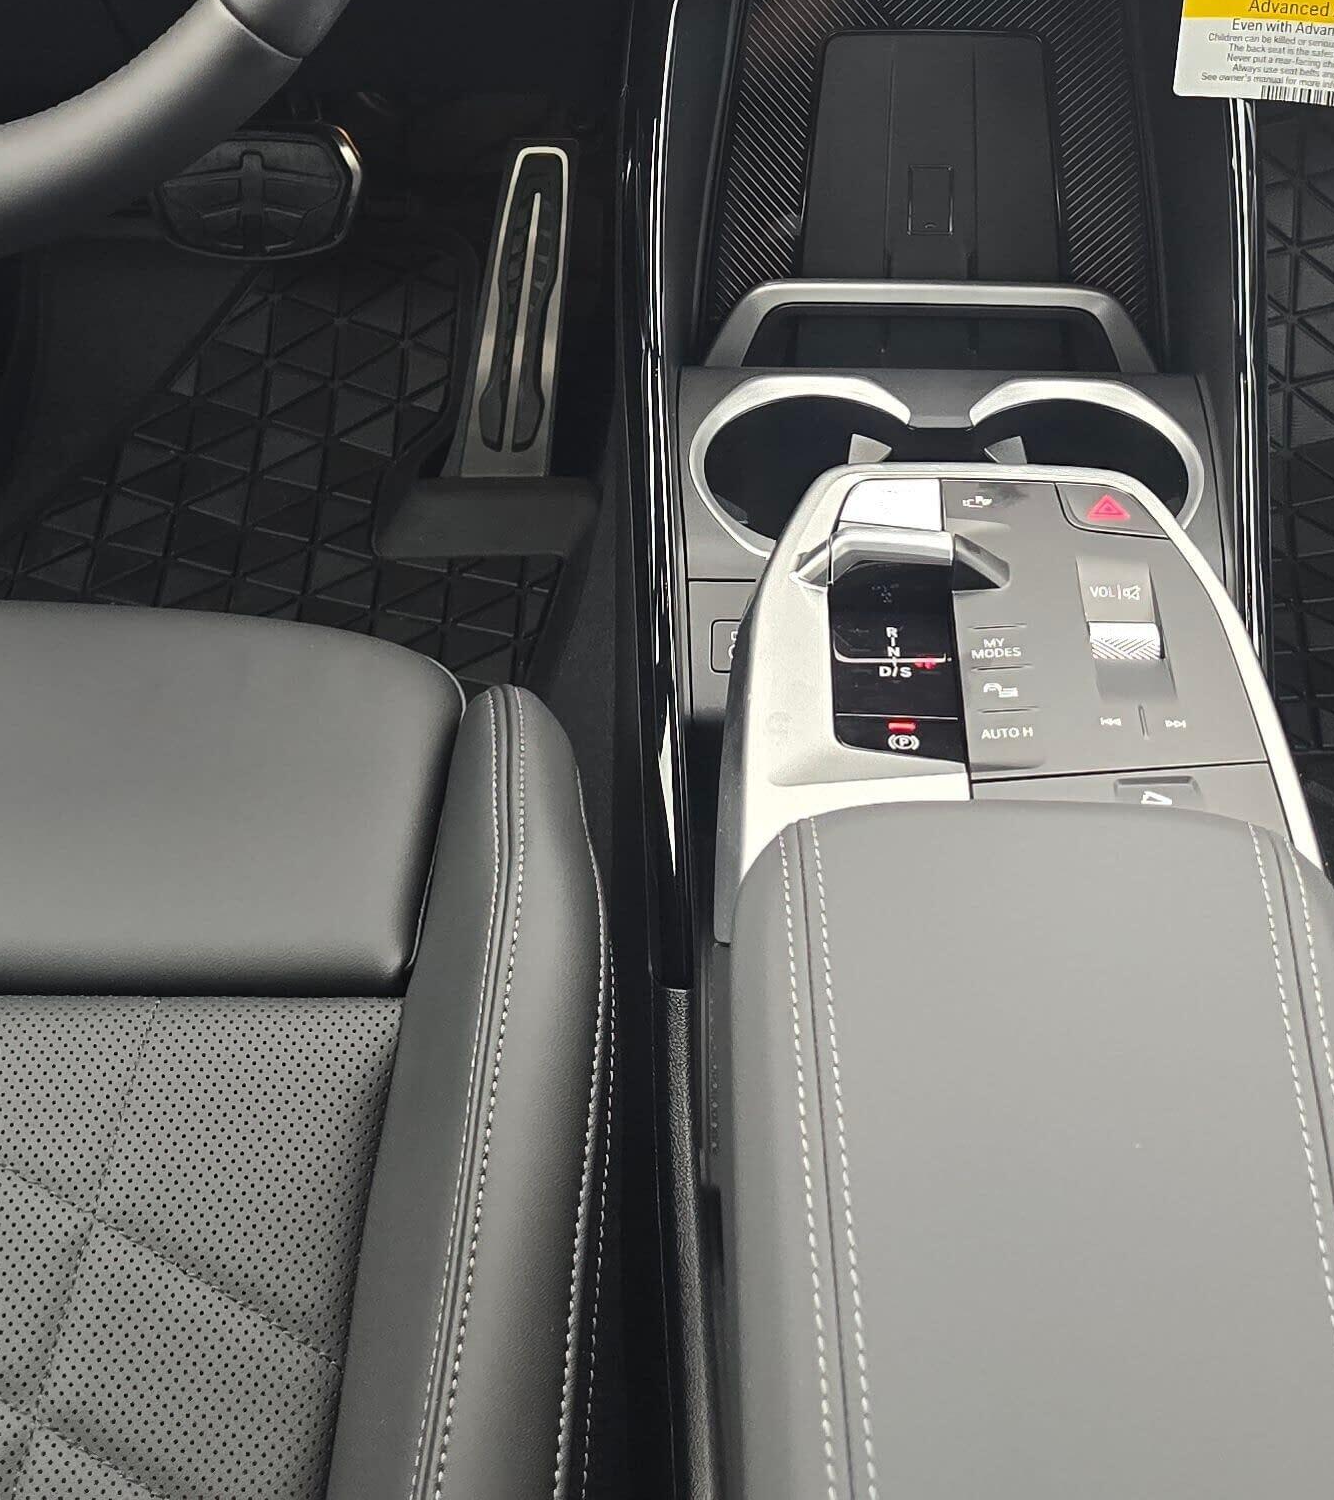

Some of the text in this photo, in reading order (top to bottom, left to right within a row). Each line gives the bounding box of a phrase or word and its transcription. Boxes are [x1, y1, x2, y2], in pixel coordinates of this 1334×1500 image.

[1232, 18, 1262, 31] Even
[1266, 20, 1292, 32] with
[1209, 33, 1242, 42] Children
[1262, 35, 1271, 43] be
[1274, 36, 1295, 44] killed
[1229, 43, 1244, 51] The
[1247, 44, 1265, 53] back
[1296, 47, 1309, 55] the
[1227, 53, 1251, 62] Never
[1275, 57, 1321, 68] rear-facing
[1089, 586, 1114, 597] VOL
[886, 627, 898, 637] R
[984, 638, 1005, 648] MY
[887, 647, 900, 657] N
[971, 647, 1022, 659] MODES
[982, 726, 1034, 739] AUTO H
